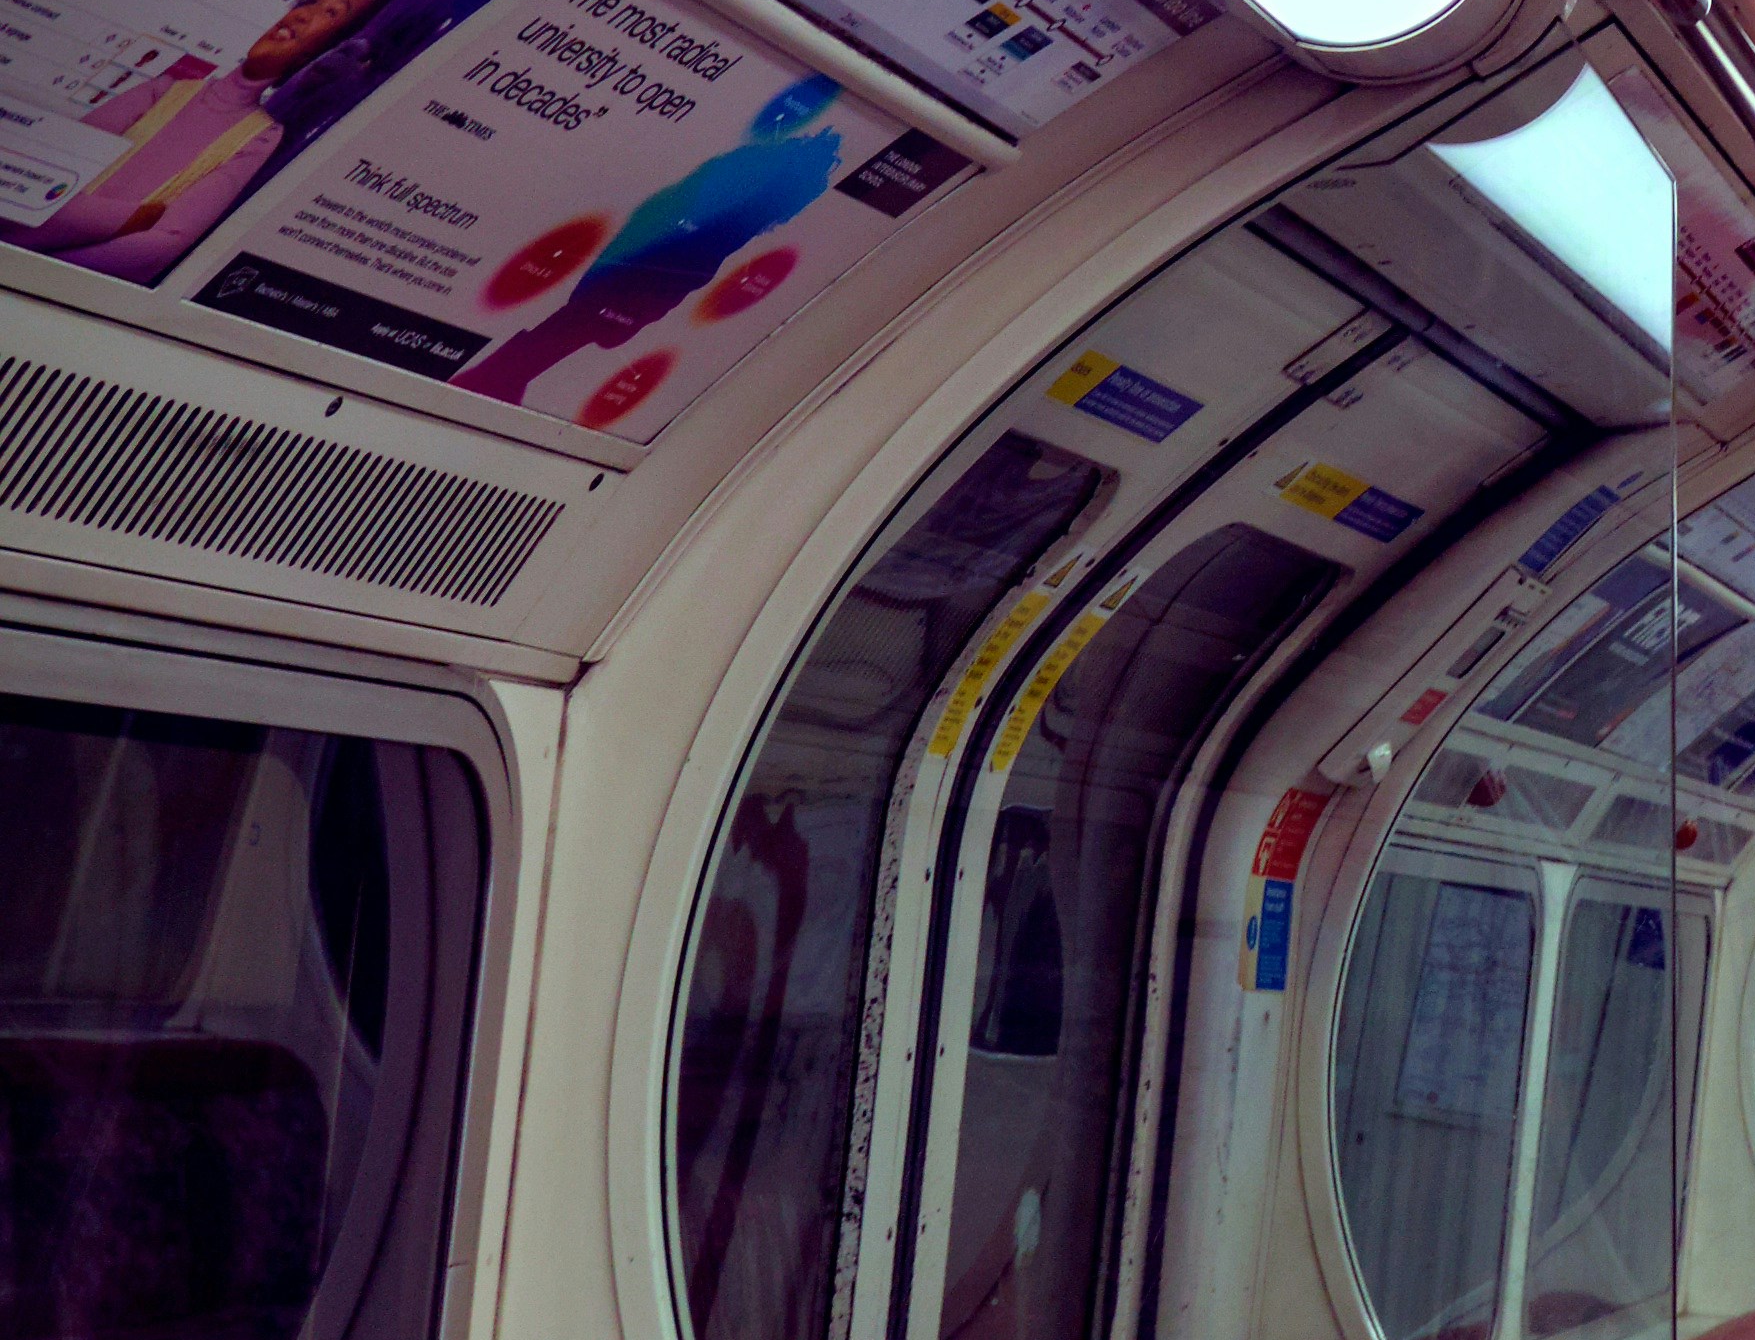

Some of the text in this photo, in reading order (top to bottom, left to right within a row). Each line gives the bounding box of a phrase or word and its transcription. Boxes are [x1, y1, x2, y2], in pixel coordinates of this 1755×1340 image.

[462, 50, 500, 85] in
[517, 18, 695, 122] university to open
[607, 4, 678, 48] most
[659, 34, 741, 81] radical
[423, 99, 495, 140] THE TIMES
[344, 158, 478, 229] Think full spectrum
[394, 330, 427, 348] UCAS
